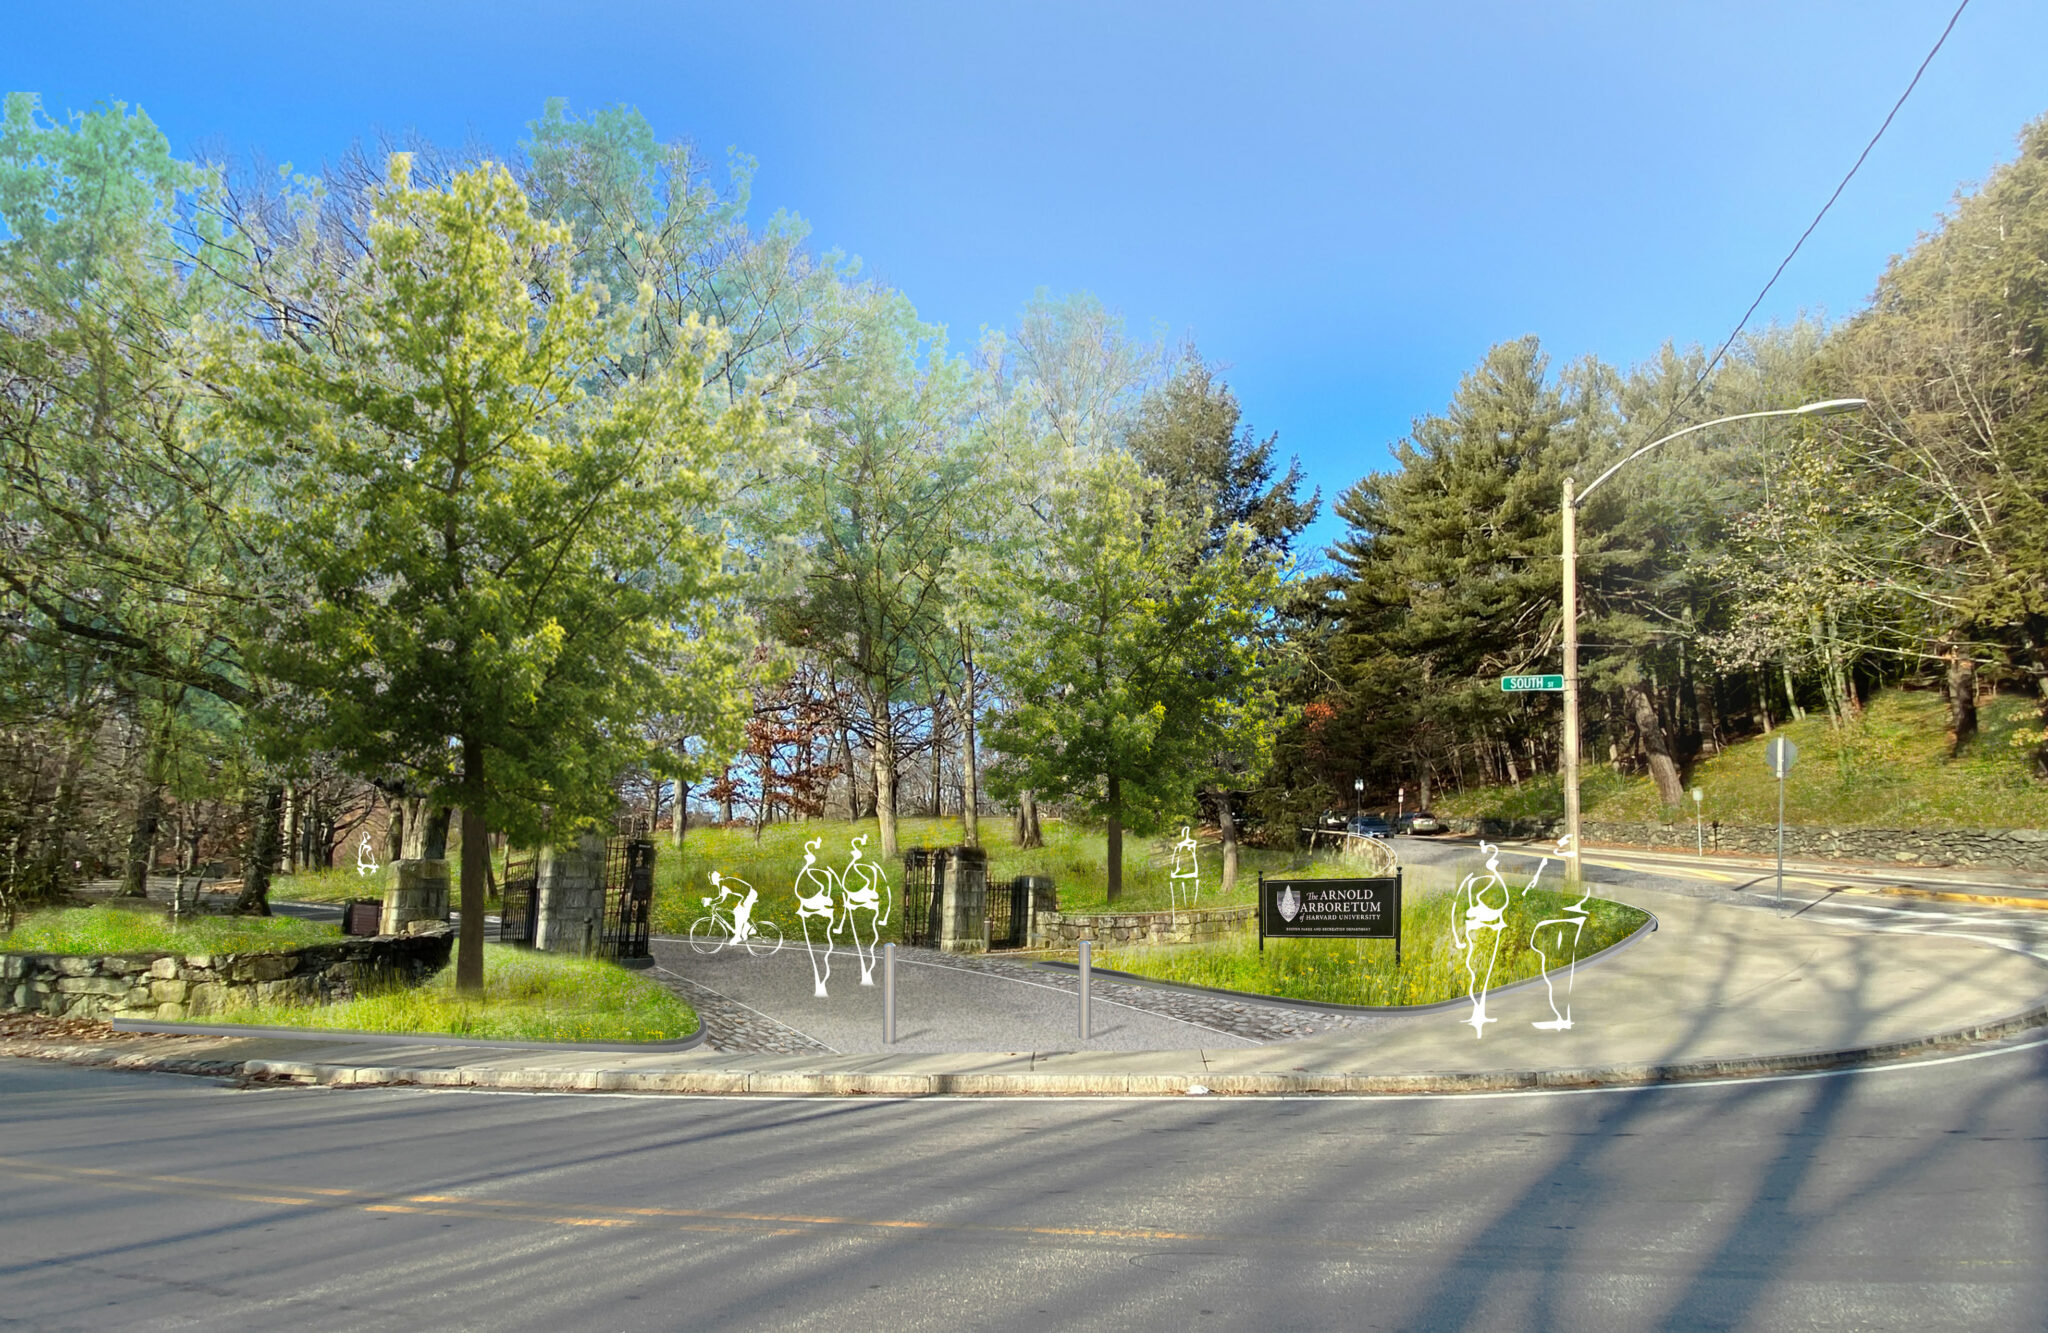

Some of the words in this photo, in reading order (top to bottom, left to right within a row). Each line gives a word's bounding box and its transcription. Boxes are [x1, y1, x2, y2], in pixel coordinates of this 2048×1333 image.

[1510, 677, 1543, 688] SOUTH
[1306, 892, 1318, 900] The
[1320, 889, 1373, 900] ARNOLD
[1300, 901, 1381, 912] ARBORETUM
[1299, 913, 1305, 922] of
